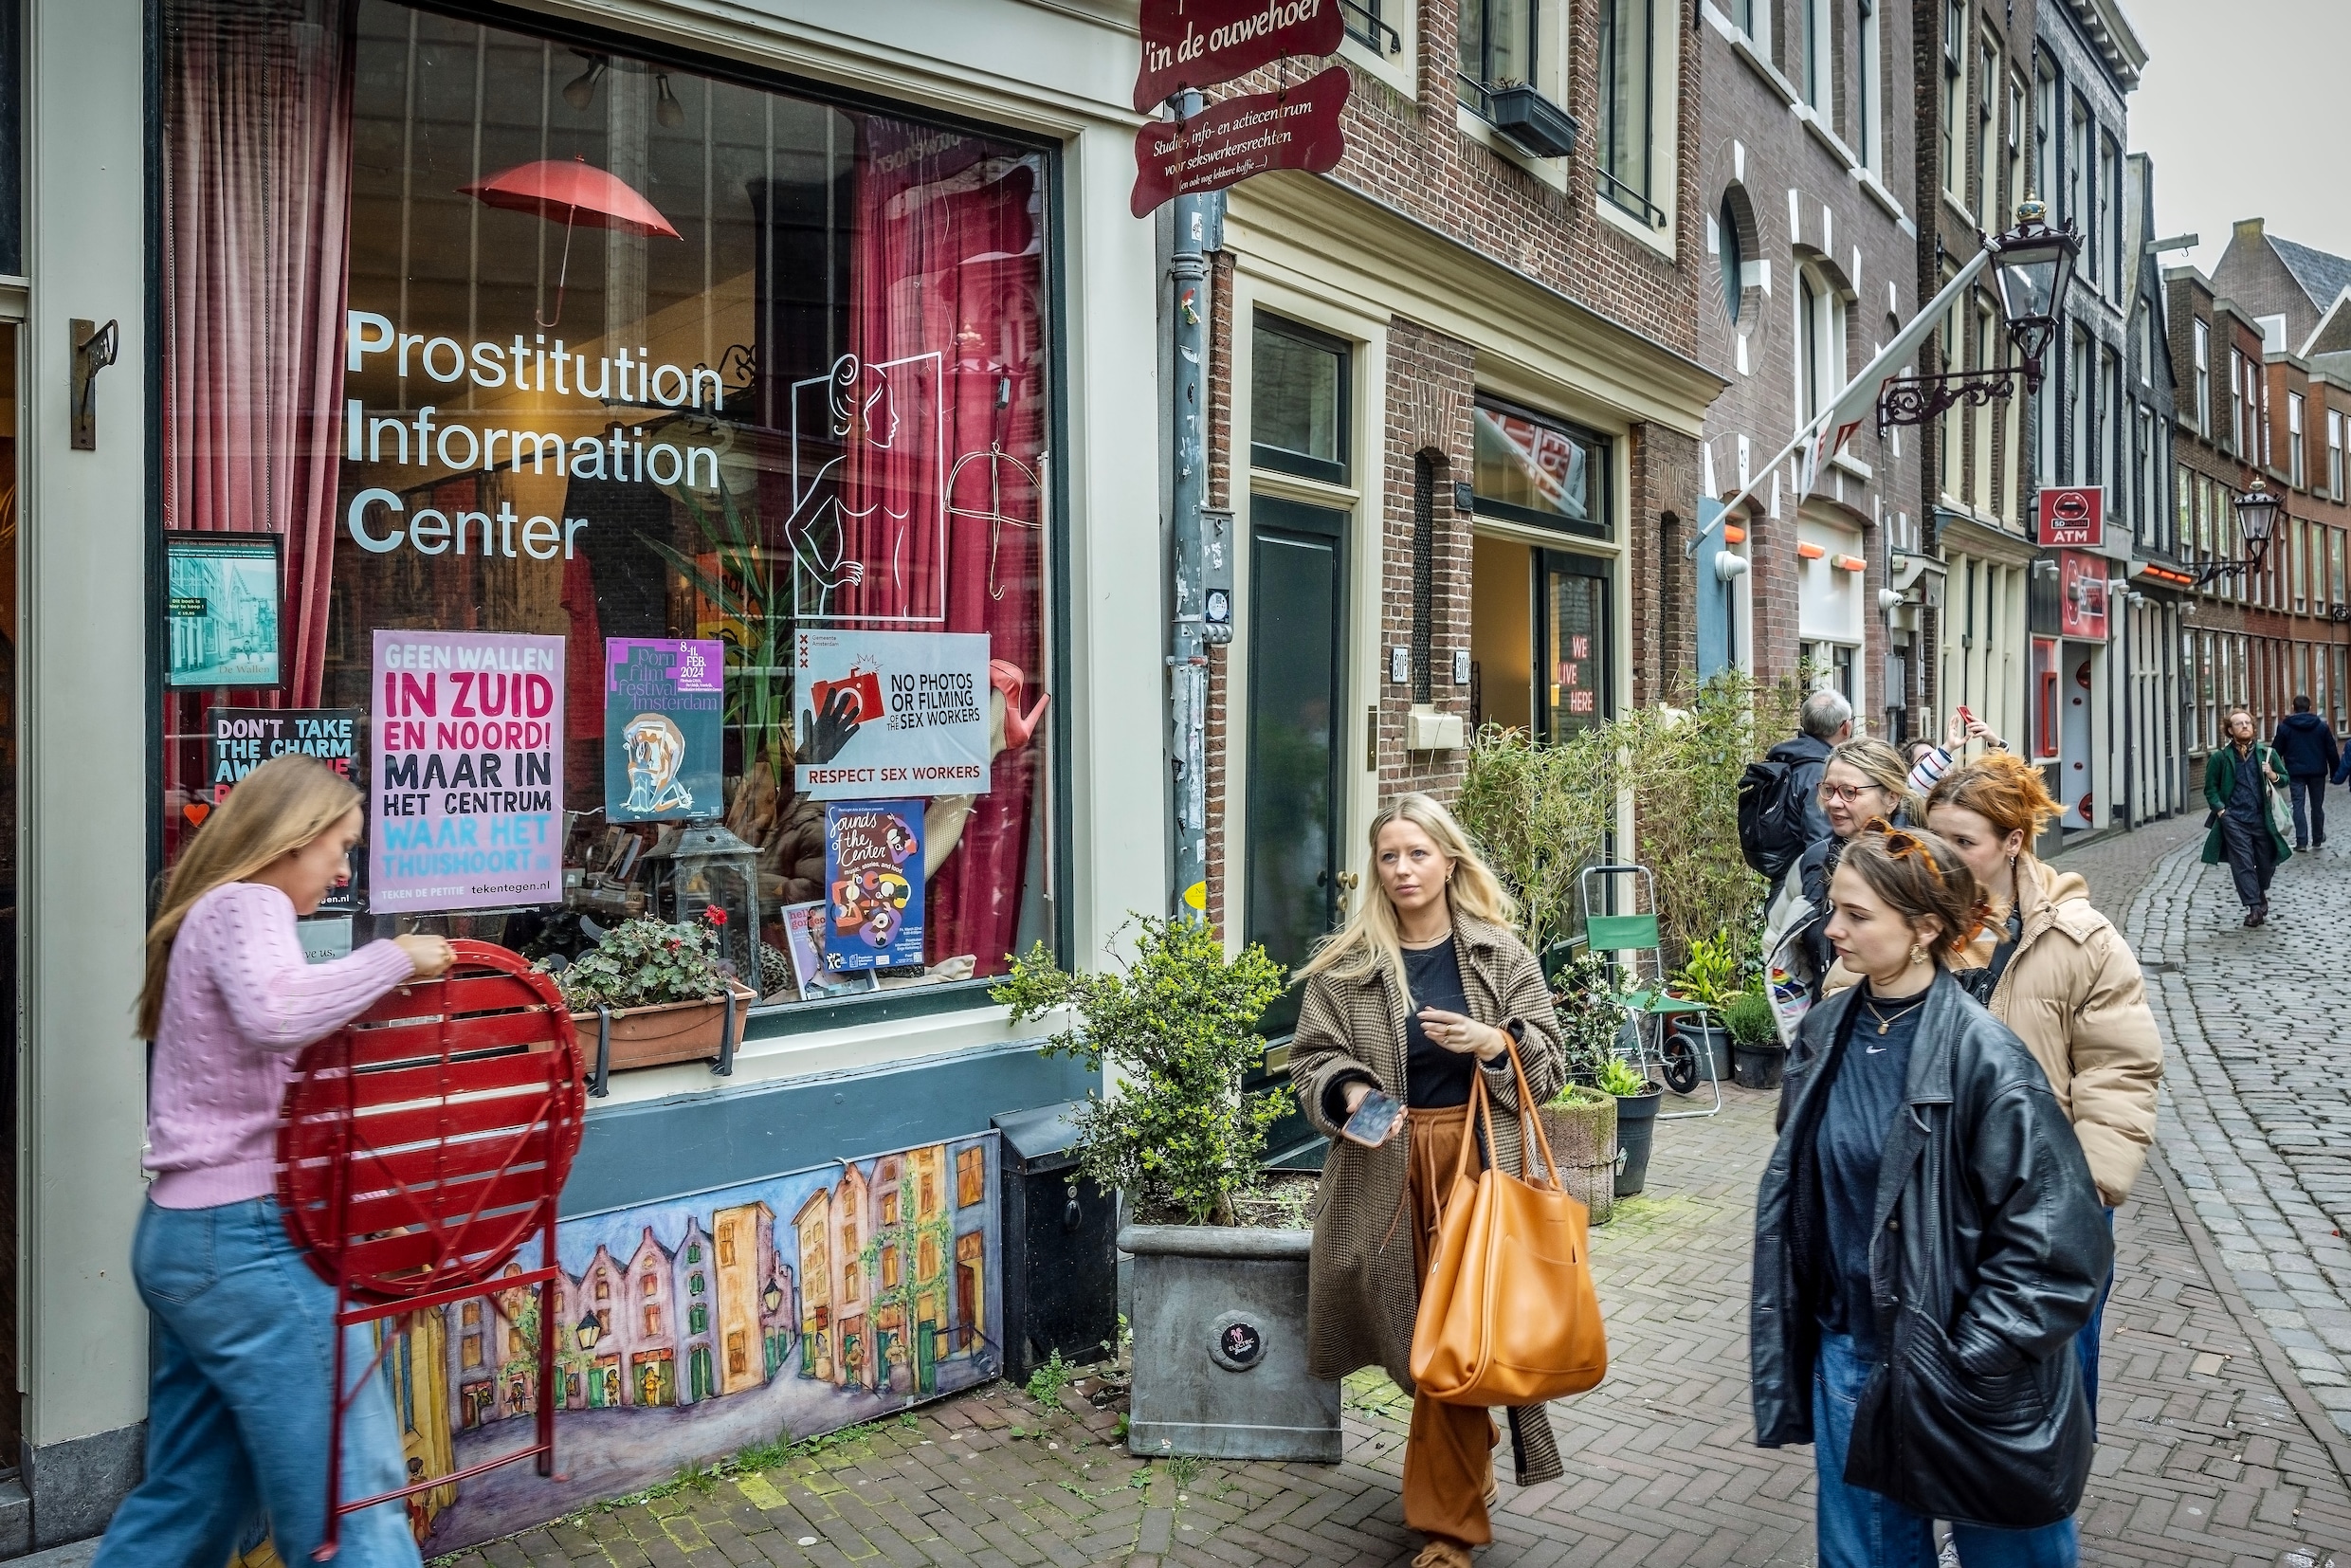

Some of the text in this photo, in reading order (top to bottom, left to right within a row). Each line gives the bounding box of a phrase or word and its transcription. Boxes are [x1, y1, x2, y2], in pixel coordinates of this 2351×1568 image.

[1177, 22, 1204, 64] de
[1210, 0, 1320, 52] ouwehoer
[1193, 122, 1215, 147] info-
[1217, 121, 1230, 136] en
[1232, 101, 1312, 131] actiecentrum
[1164, 128, 1292, 176] voor sekswerkersrechten
[1189, 174, 1200, 187] ook
[1200, 173, 1212, 186] nog
[1212, 165, 1235, 180] lekkere
[1235, 158, 1254, 175] koffie
[347, 309, 723, 411] Prostitution
[347, 398, 720, 488] Information
[348, 487, 588, 559] Center
[2053, 531, 2087, 542] ATM
[385, 644, 554, 671] GEEN WALLEN
[638, 648, 675, 665] Porn
[1573, 637, 1587, 658] WE
[237, 665, 270, 674] Wallen
[686, 656, 706, 667] FEB.
[681, 666, 703, 678] 2024
[1558, 664, 1577, 684] LIVE
[891, 673, 973, 692] NO PHOTOS
[385, 671, 554, 718] IN ZUID
[626, 693, 717, 711] Amsterdam
[892, 690, 974, 712] OR FILMING
[1570, 692, 1593, 711] HERE
[218, 719, 354, 738] DON'T TAKE
[886, 722, 900, 732] THE
[890, 708, 980, 730] OF SEX WORKERS
[384, 720, 551, 751] EN NOORD!
[216, 739, 351, 758] THE CHARM
[384, 753, 502, 790] MAAR
[516, 753, 552, 787] IN
[809, 766, 980, 784] RESPECT SEX WORKERS
[383, 791, 552, 816] HET CENTRUM
[383, 814, 552, 851] WAAR HET
[829, 807, 877, 839] Sounds
[832, 830, 870, 865] of the
[841, 840, 886, 866] Center
[382, 848, 533, 879] THUISHOORT
[844, 866, 861, 875] music,
[891, 865, 903, 874] food
[318, 894, 350, 904] gen.nl
[381, 881, 550, 900] TEKEN DE PETITIE tekentegen.nl
[789, 908, 816, 920] hello
[791, 917, 826, 930] gorgeo
[304, 949, 336, 958] ve us,
[1229, 1338, 1254, 1352] ELECTRIC
